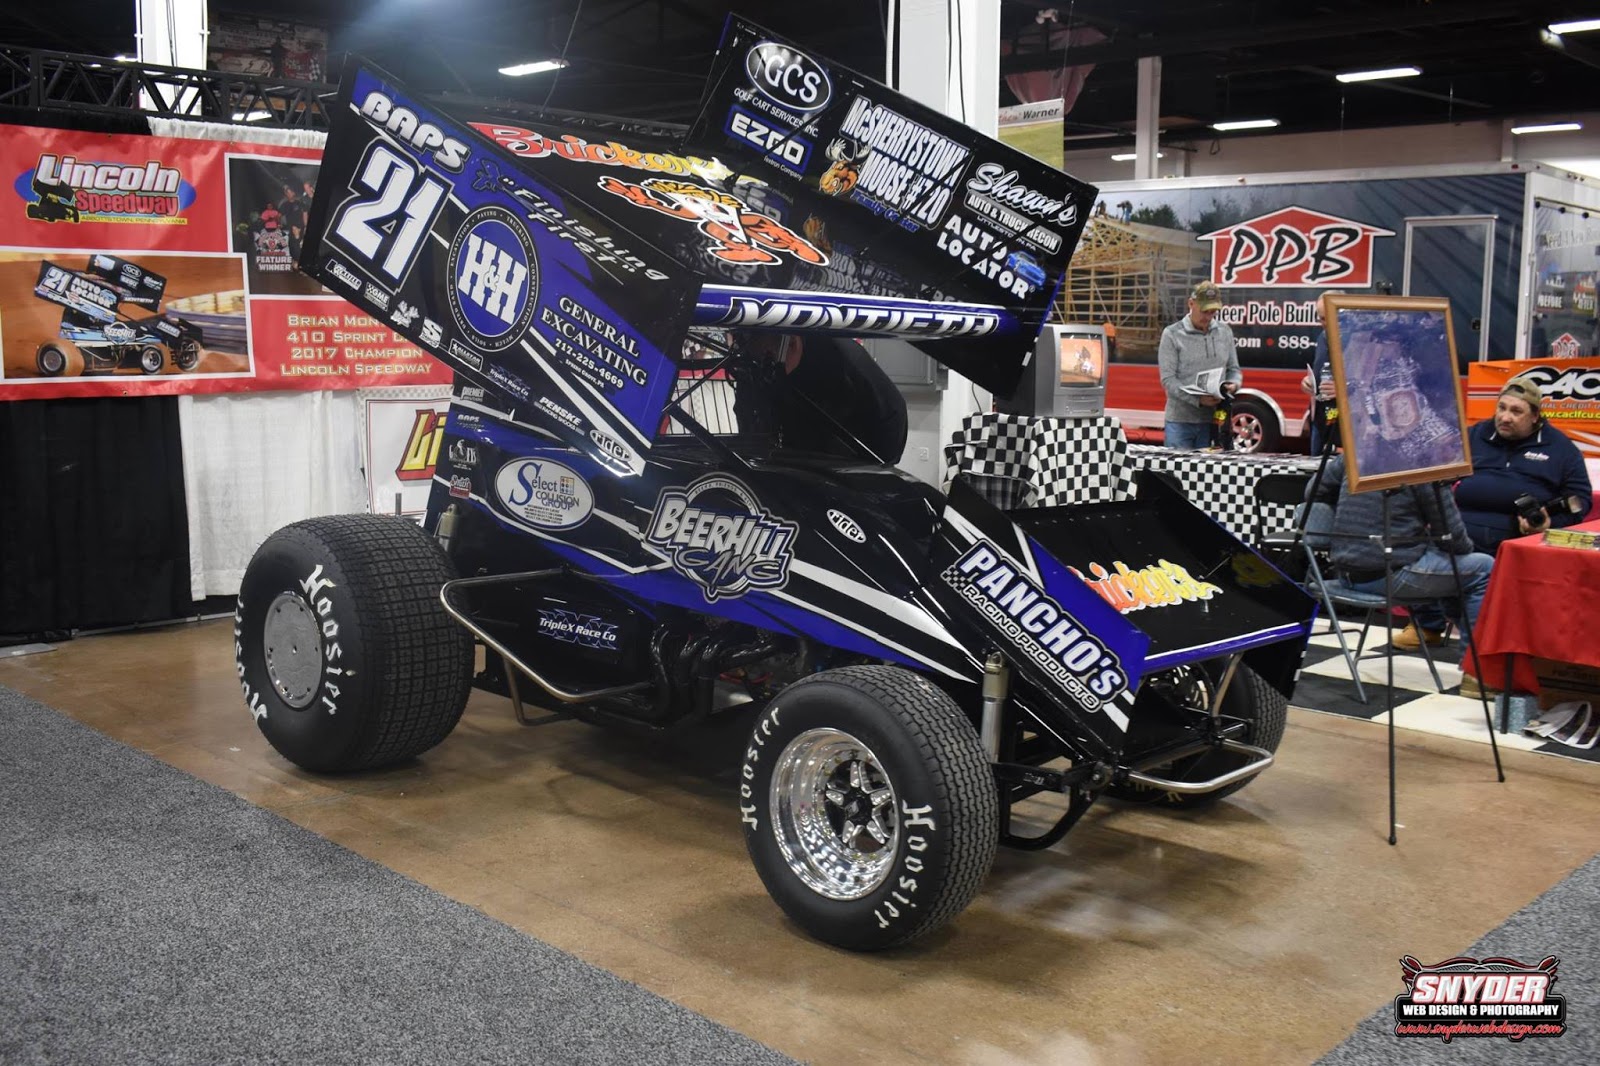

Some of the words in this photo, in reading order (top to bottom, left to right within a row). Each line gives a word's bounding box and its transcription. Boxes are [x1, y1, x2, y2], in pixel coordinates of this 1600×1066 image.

[765, 54, 821, 103] GCS
[734, 87, 753, 102] GOLF
[752, 96, 772, 112] CART
[1023, 107, 1059, 120] Warner
[361, 91, 470, 171] BAPS
[731, 113, 805, 165] EZGO
[35, 155, 181, 193] Lincoln
[780, 164, 803, 181] Company
[857, 150, 914, 205] MOOSE
[75, 189, 178, 216] Speedway
[336, 146, 444, 280] 21
[477, 210, 497, 220] PAVING
[968, 163, 1076, 226] Shawn's
[968, 194, 992, 214] AUTO
[991, 207, 999, 219] &
[450, 223, 470, 267] EXCAVATION
[506, 215, 530, 247] TRUCKING
[945, 214, 1008, 260] AUTO
[256, 255, 292, 264] FEATURE
[258, 263, 292, 271] WINNER
[1225, 227, 1359, 281] PPB
[45, 268, 71, 294] 21
[72, 277, 101, 294] AUTO
[458, 233, 527, 325] H&H
[521, 263, 536, 326] CONSTRUCTION
[287, 314, 339, 327] BRIAN
[344, 315, 386, 327] MON
[559, 297, 640, 357] GENERAL
[1249, 303, 1280, 322] Pole
[287, 331, 326, 343] 410
[333, 331, 386, 343] SPRINT
[291, 347, 338, 360] 2017
[345, 347, 423, 359] CHAMPION
[541, 307, 648, 386] EXCAVATING
[281, 363, 350, 377] LINCOLN
[354, 362, 432, 375] SPEEDWAY
[555, 337, 624, 388] 717-225-4669
[539, 396, 583, 426] PENSKE
[595, 431, 630, 460] rider
[508, 462, 557, 506] Select
[656, 498, 785, 562] BEERHILL
[829, 512, 864, 542] rider
[299, 564, 356, 715] Hoosier
[540, 617, 575, 633] TripleX
[575, 625, 601, 639] Race
[602, 631, 617, 641] Co
[960, 547, 1122, 695] PANCHO'S
[963, 585, 1021, 638] RACING
[1014, 632, 1101, 711] PRODUCTS
[741, 707, 781, 831] Hoosier
[874, 800, 937, 929] Hoosier
